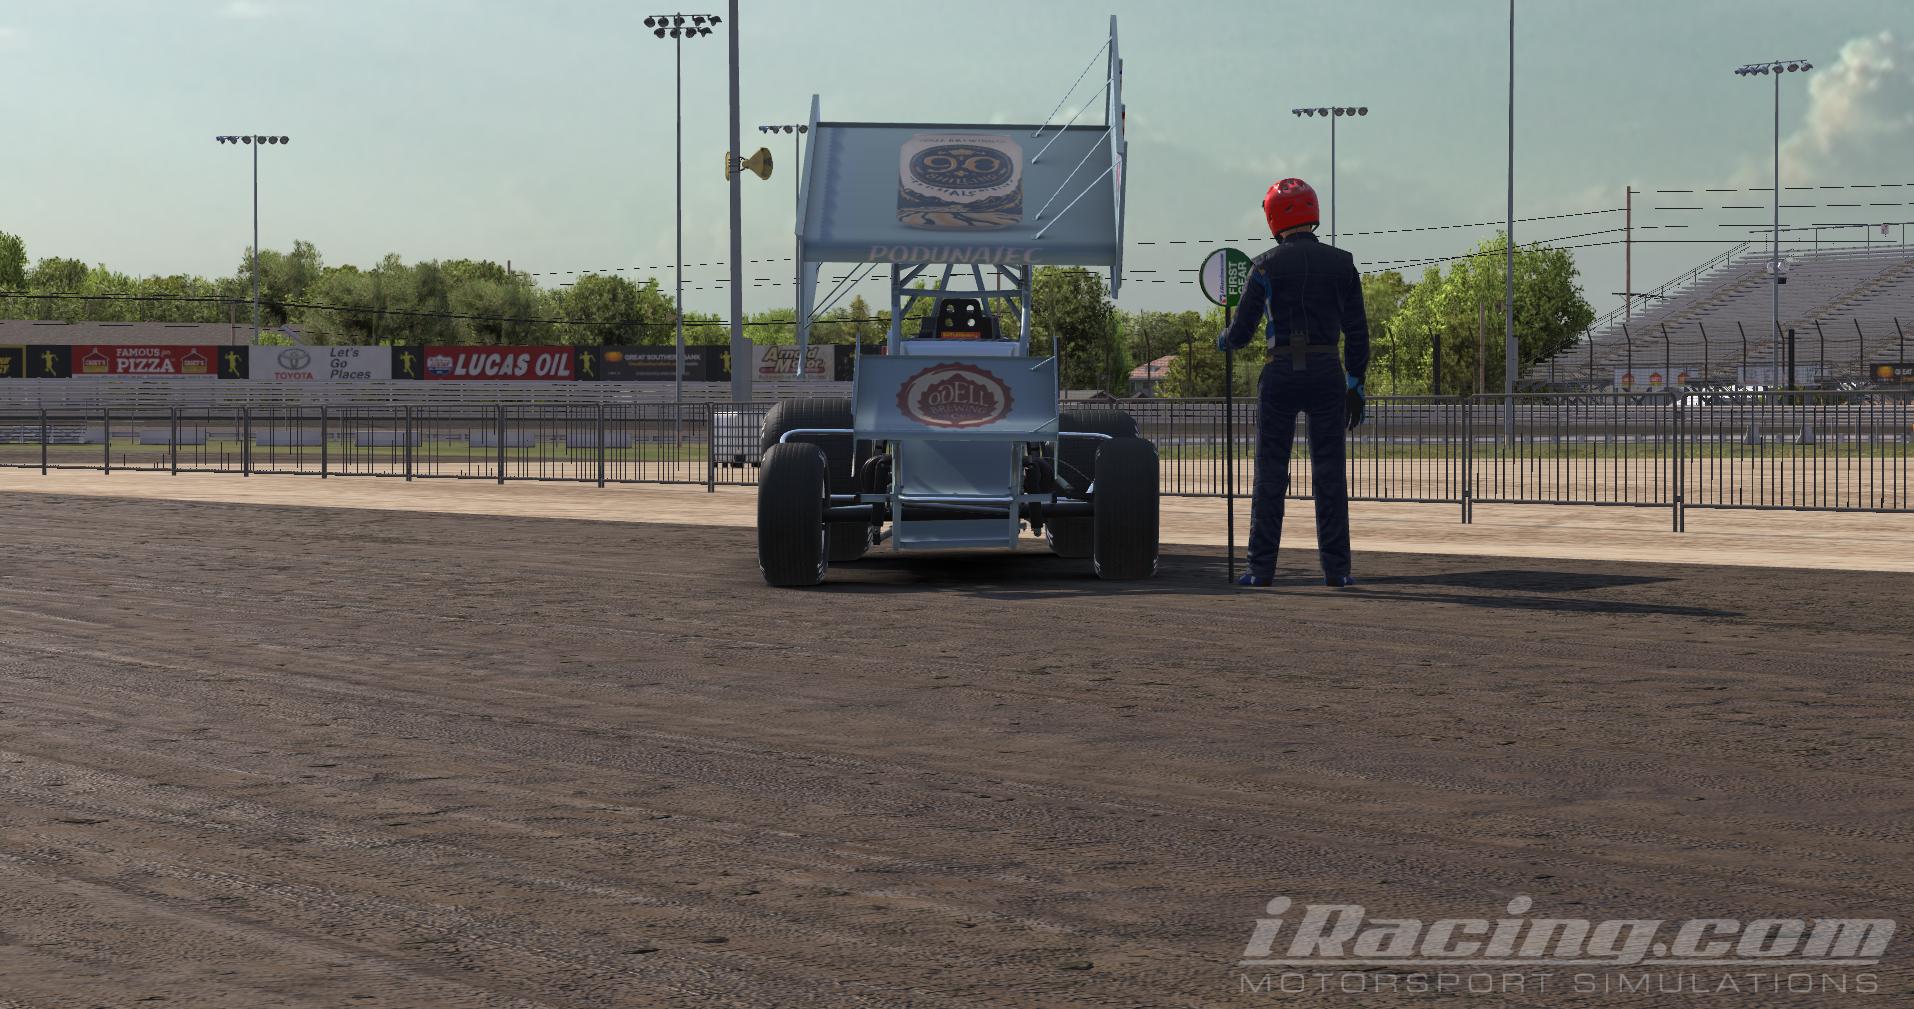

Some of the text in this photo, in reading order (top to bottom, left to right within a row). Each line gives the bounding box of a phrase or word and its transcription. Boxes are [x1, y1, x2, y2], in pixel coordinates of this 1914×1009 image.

[1228, 261, 1238, 295] FIRST
[116, 348, 160, 357] FAMOUS
[330, 347, 359, 358] Let's
[116, 358, 175, 373] PIZZA
[330, 358, 347, 369] Go
[454, 353, 531, 376] LUCAS
[535, 353, 570, 376] OIL
[275, 372, 314, 380] TOYOTA
[330, 369, 371, 380] Places
[929, 381, 989, 407] ODELL
